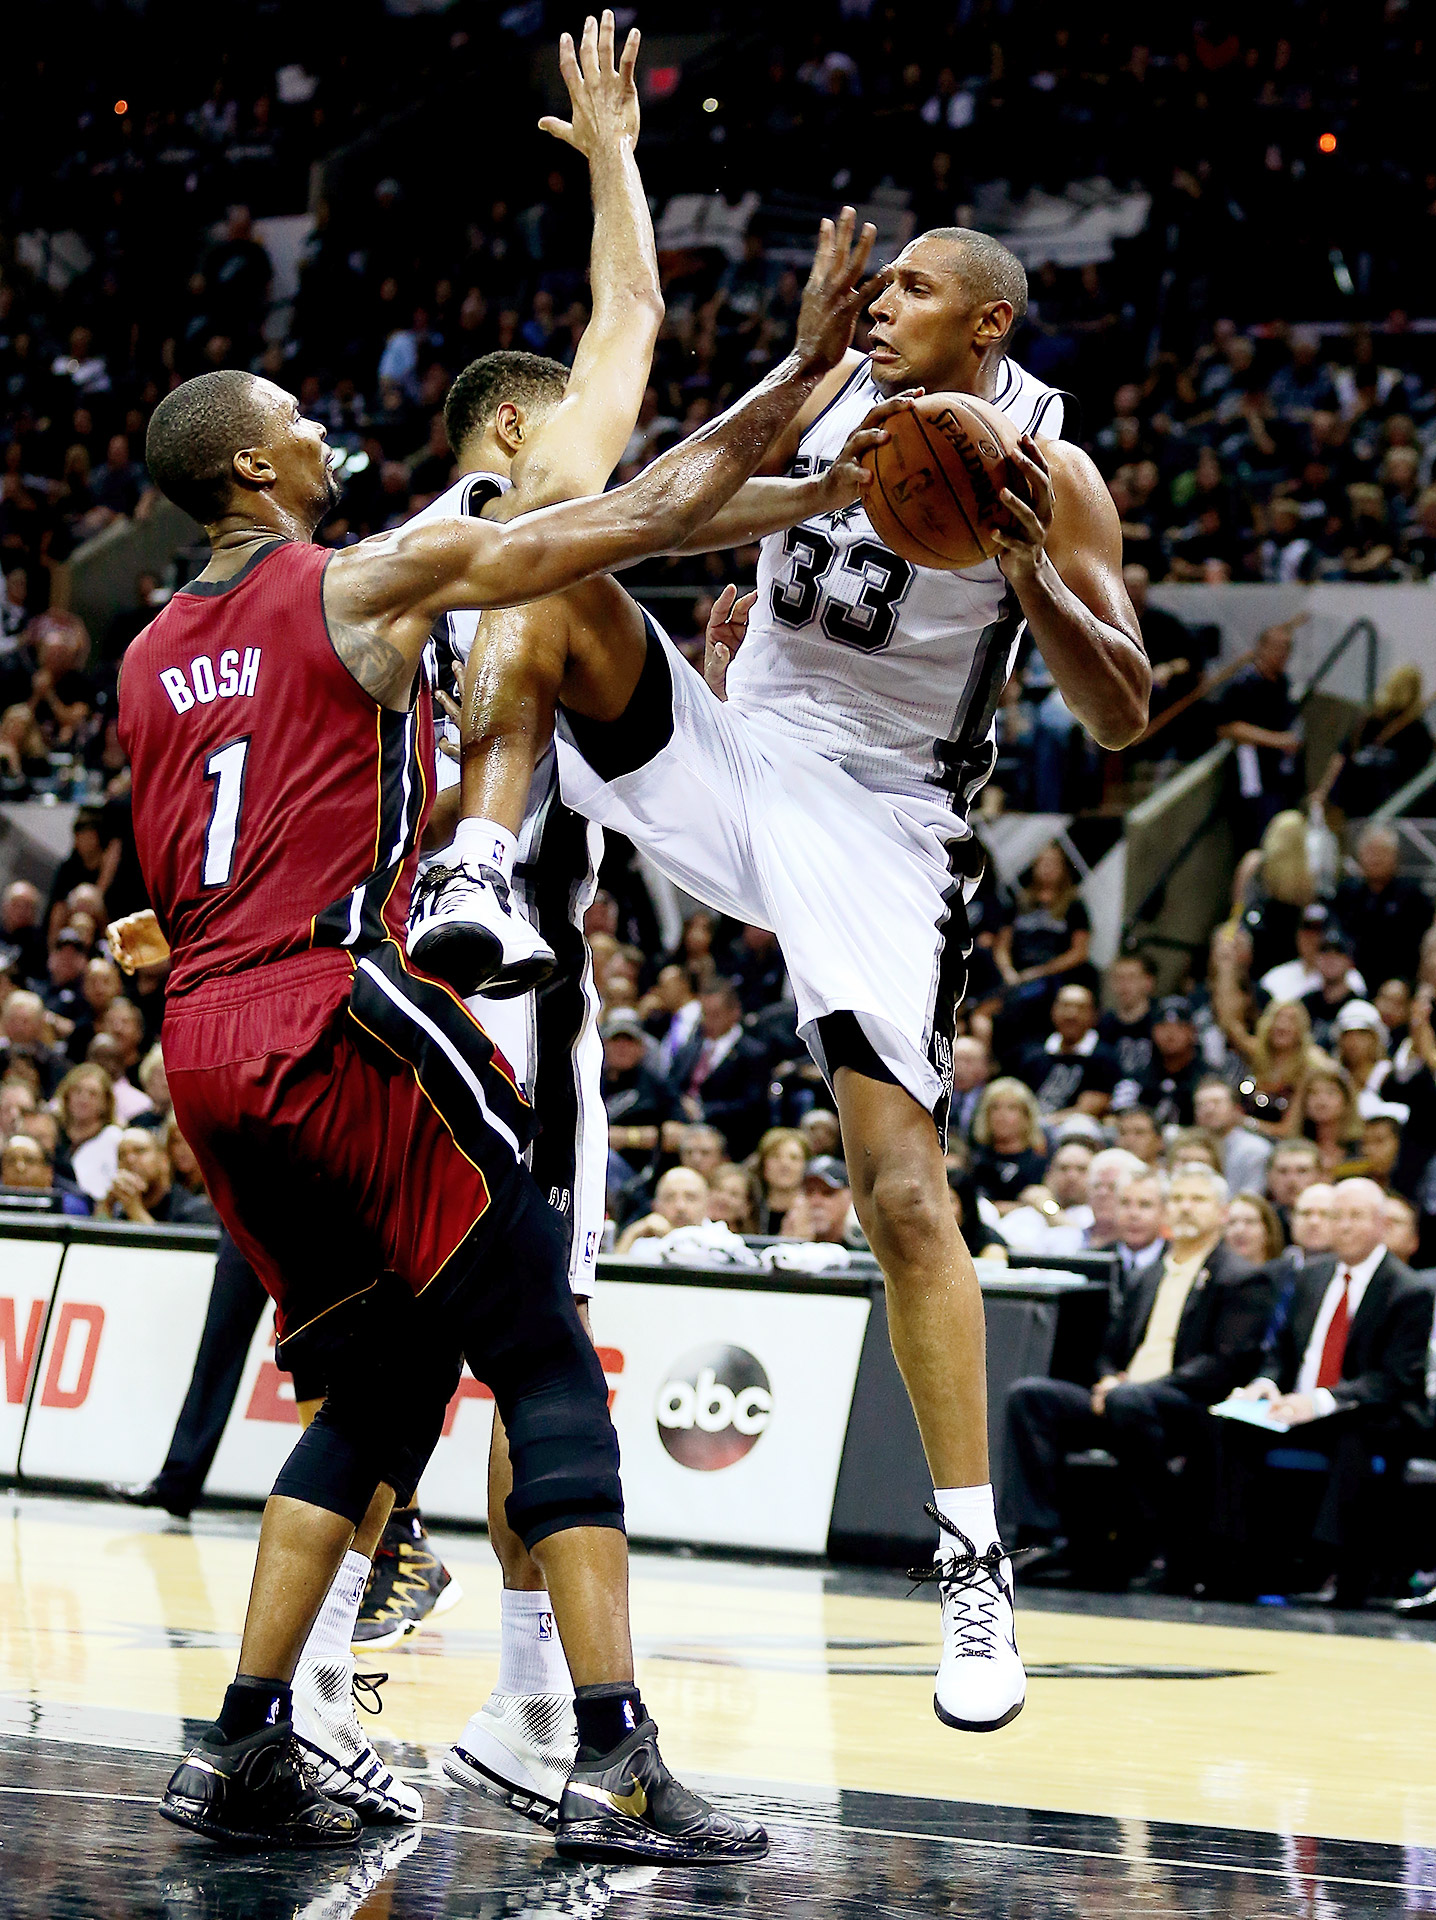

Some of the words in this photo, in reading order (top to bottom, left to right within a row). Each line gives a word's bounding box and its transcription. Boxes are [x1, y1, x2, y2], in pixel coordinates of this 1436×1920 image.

[769, 525, 917, 654] 33
[158, 646, 262, 716] BOSH
[202, 735, 252, 888] 1
[656, 1366, 774, 1436] abc
